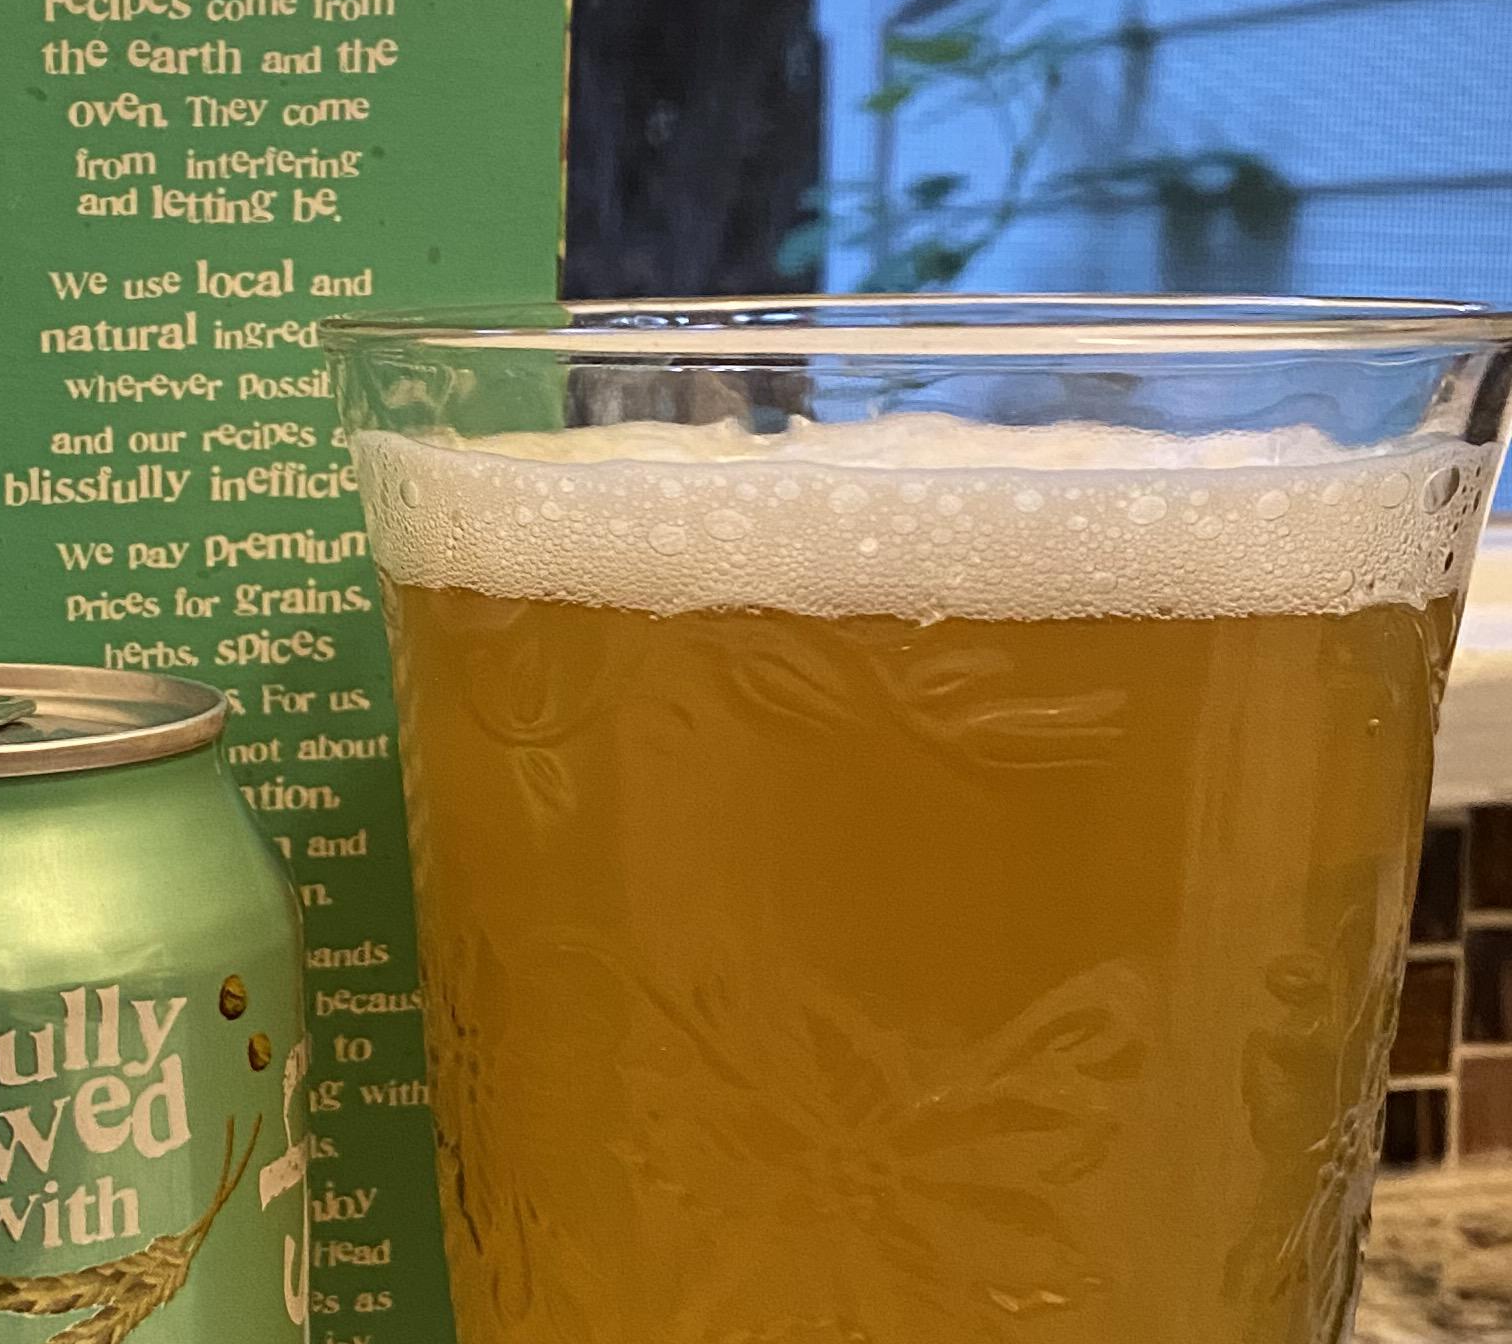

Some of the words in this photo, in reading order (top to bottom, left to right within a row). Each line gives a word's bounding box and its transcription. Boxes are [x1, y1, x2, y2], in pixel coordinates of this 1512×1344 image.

[42, 36, 108, 75] the
[127, 36, 241, 75] earth
[262, 46, 321, 74] and
[337, 37, 398, 74] the
[187, 95, 267, 127] They
[283, 95, 369, 127] come
[76, 148, 156, 178] from
[186, 146, 362, 180] interfering
[77, 188, 138, 215] and
[152, 185, 277, 222] letting
[293, 188, 342, 222] be.
[49, 270, 107, 300] We
[124, 269, 181, 299] use
[197, 259, 293, 297] local
[310, 268, 373, 296] and
[41, 312, 197, 352] natural
[214, 317, 319, 350] ingred
[65, 371, 222, 403] wherever
[51, 427, 113, 455] and
[129, 430, 187, 452] our
[203, 420, 316, 453] recipes
[4, 467, 191, 507] blissfully
[210, 462, 358, 501] inefficie
[56, 542, 113, 572] We
[128, 543, 190, 569] pay
[67, 590, 159, 622] prices
[175, 588, 220, 617] for
[215, 629, 336, 664] spices
[262, 685, 316, 714] For
[229, 737, 281, 764] not
[297, 734, 389, 760] about
[307, 829, 367, 856] and
[308, 940, 390, 968] ands
[316, 989, 426, 1016] becaus
[334, 1034, 373, 1062] to
[360, 1081, 430, 1106] with
[354, 1291, 392, 1313] as
